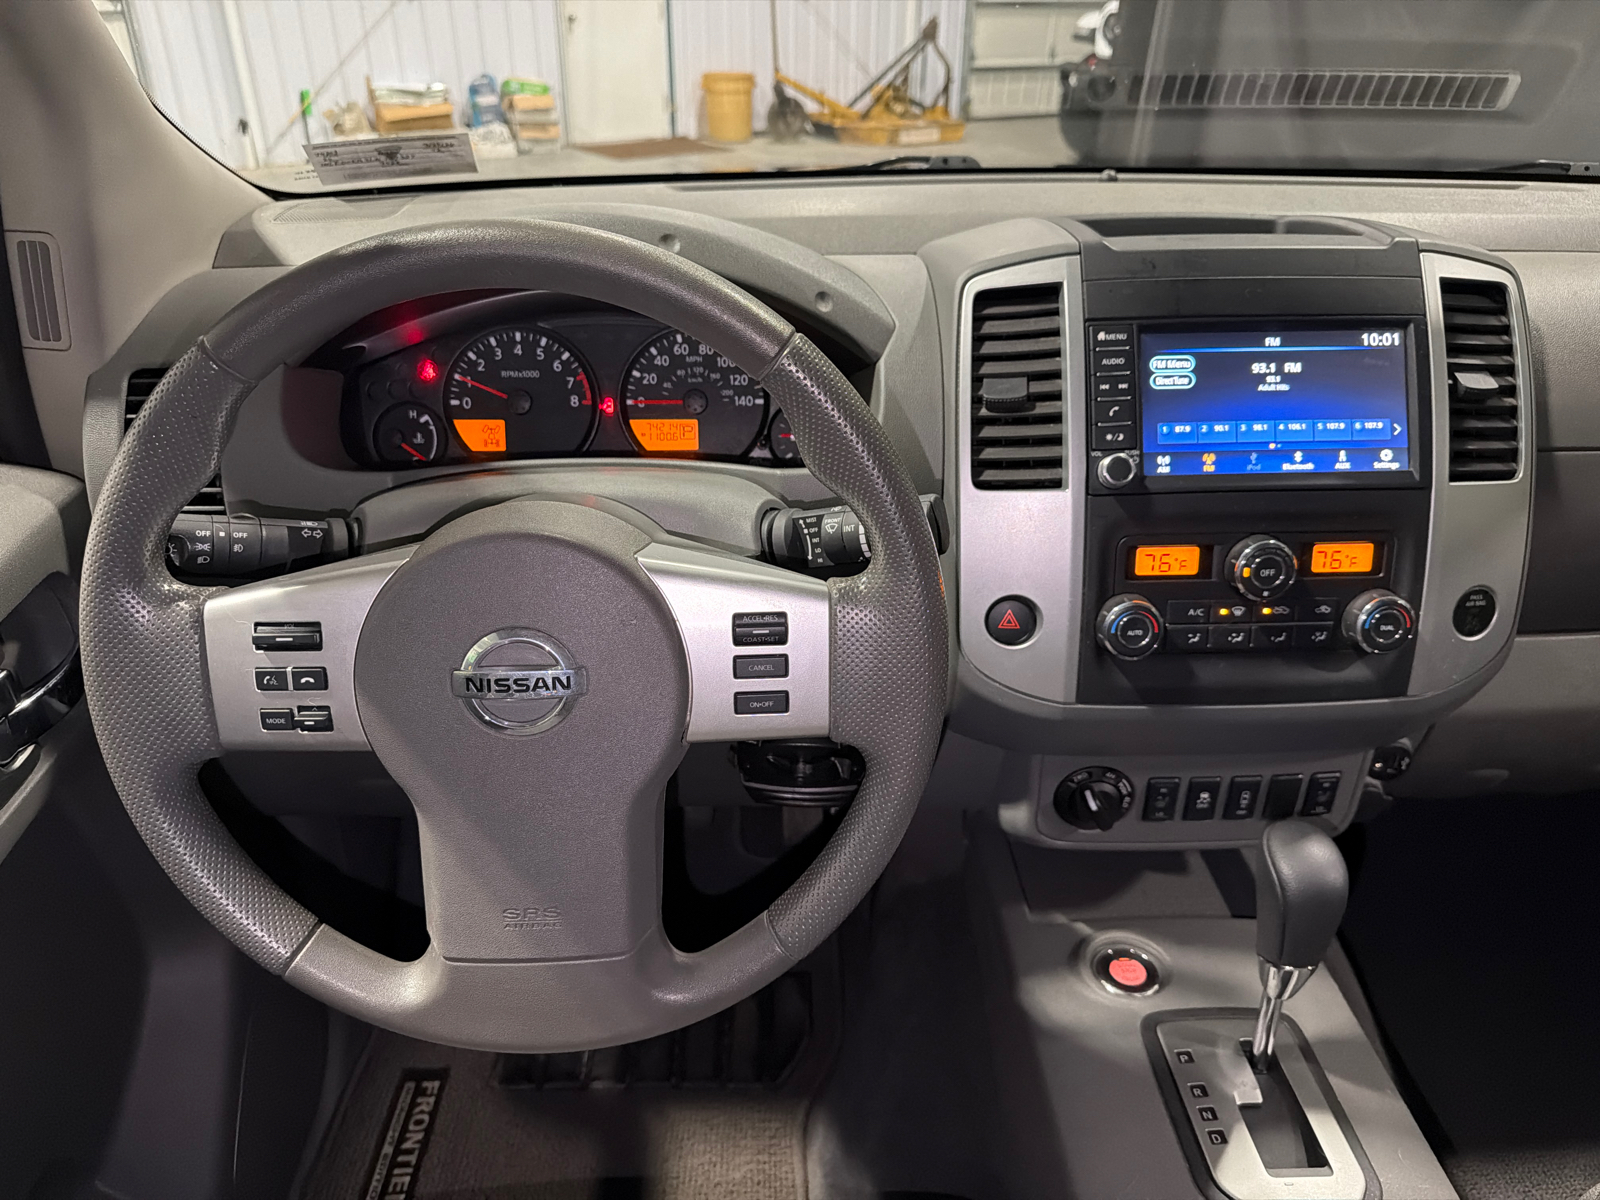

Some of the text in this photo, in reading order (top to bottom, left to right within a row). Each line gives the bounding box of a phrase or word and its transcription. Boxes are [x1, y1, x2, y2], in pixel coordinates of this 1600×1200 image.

[1265, 337, 1281, 347] FM
[1361, 332, 1400, 346] 10:01
[494, 348, 502, 360] 3
[513, 344, 522, 356] 4
[536, 348, 545, 360] 5
[673, 344, 689, 356] 60
[698, 344, 714, 356] 80
[477, 359, 486, 372] 2
[553, 359, 562, 372] 6
[654, 355, 669, 367] 40
[1101, 357, 1125, 365] AUDIO
[1251, 362, 1302, 373] 93.1 FM
[566, 377, 574, 389] 7
[642, 373, 657, 385] 20
[729, 374, 749, 386] 120
[462, 397, 472, 409] 0
[570, 394, 579, 407] 8
[734, 395, 753, 406] 140
[409, 409, 417, 419] H
[646, 422, 678, 432] 74214
[682, 425, 694, 438] P
[843, 524, 855, 533] INT
[1260, 568, 1276, 577] OFF
[1188, 608, 1205, 617] A/C
[465, 675, 571, 693] NISSAN
[502, 907, 561, 920] SRS
[1179, 1054, 1189, 1064] P
[1193, 1087, 1204, 1097] R
[1203, 1110, 1213, 1120] N
[1211, 1133, 1221, 1144] D
